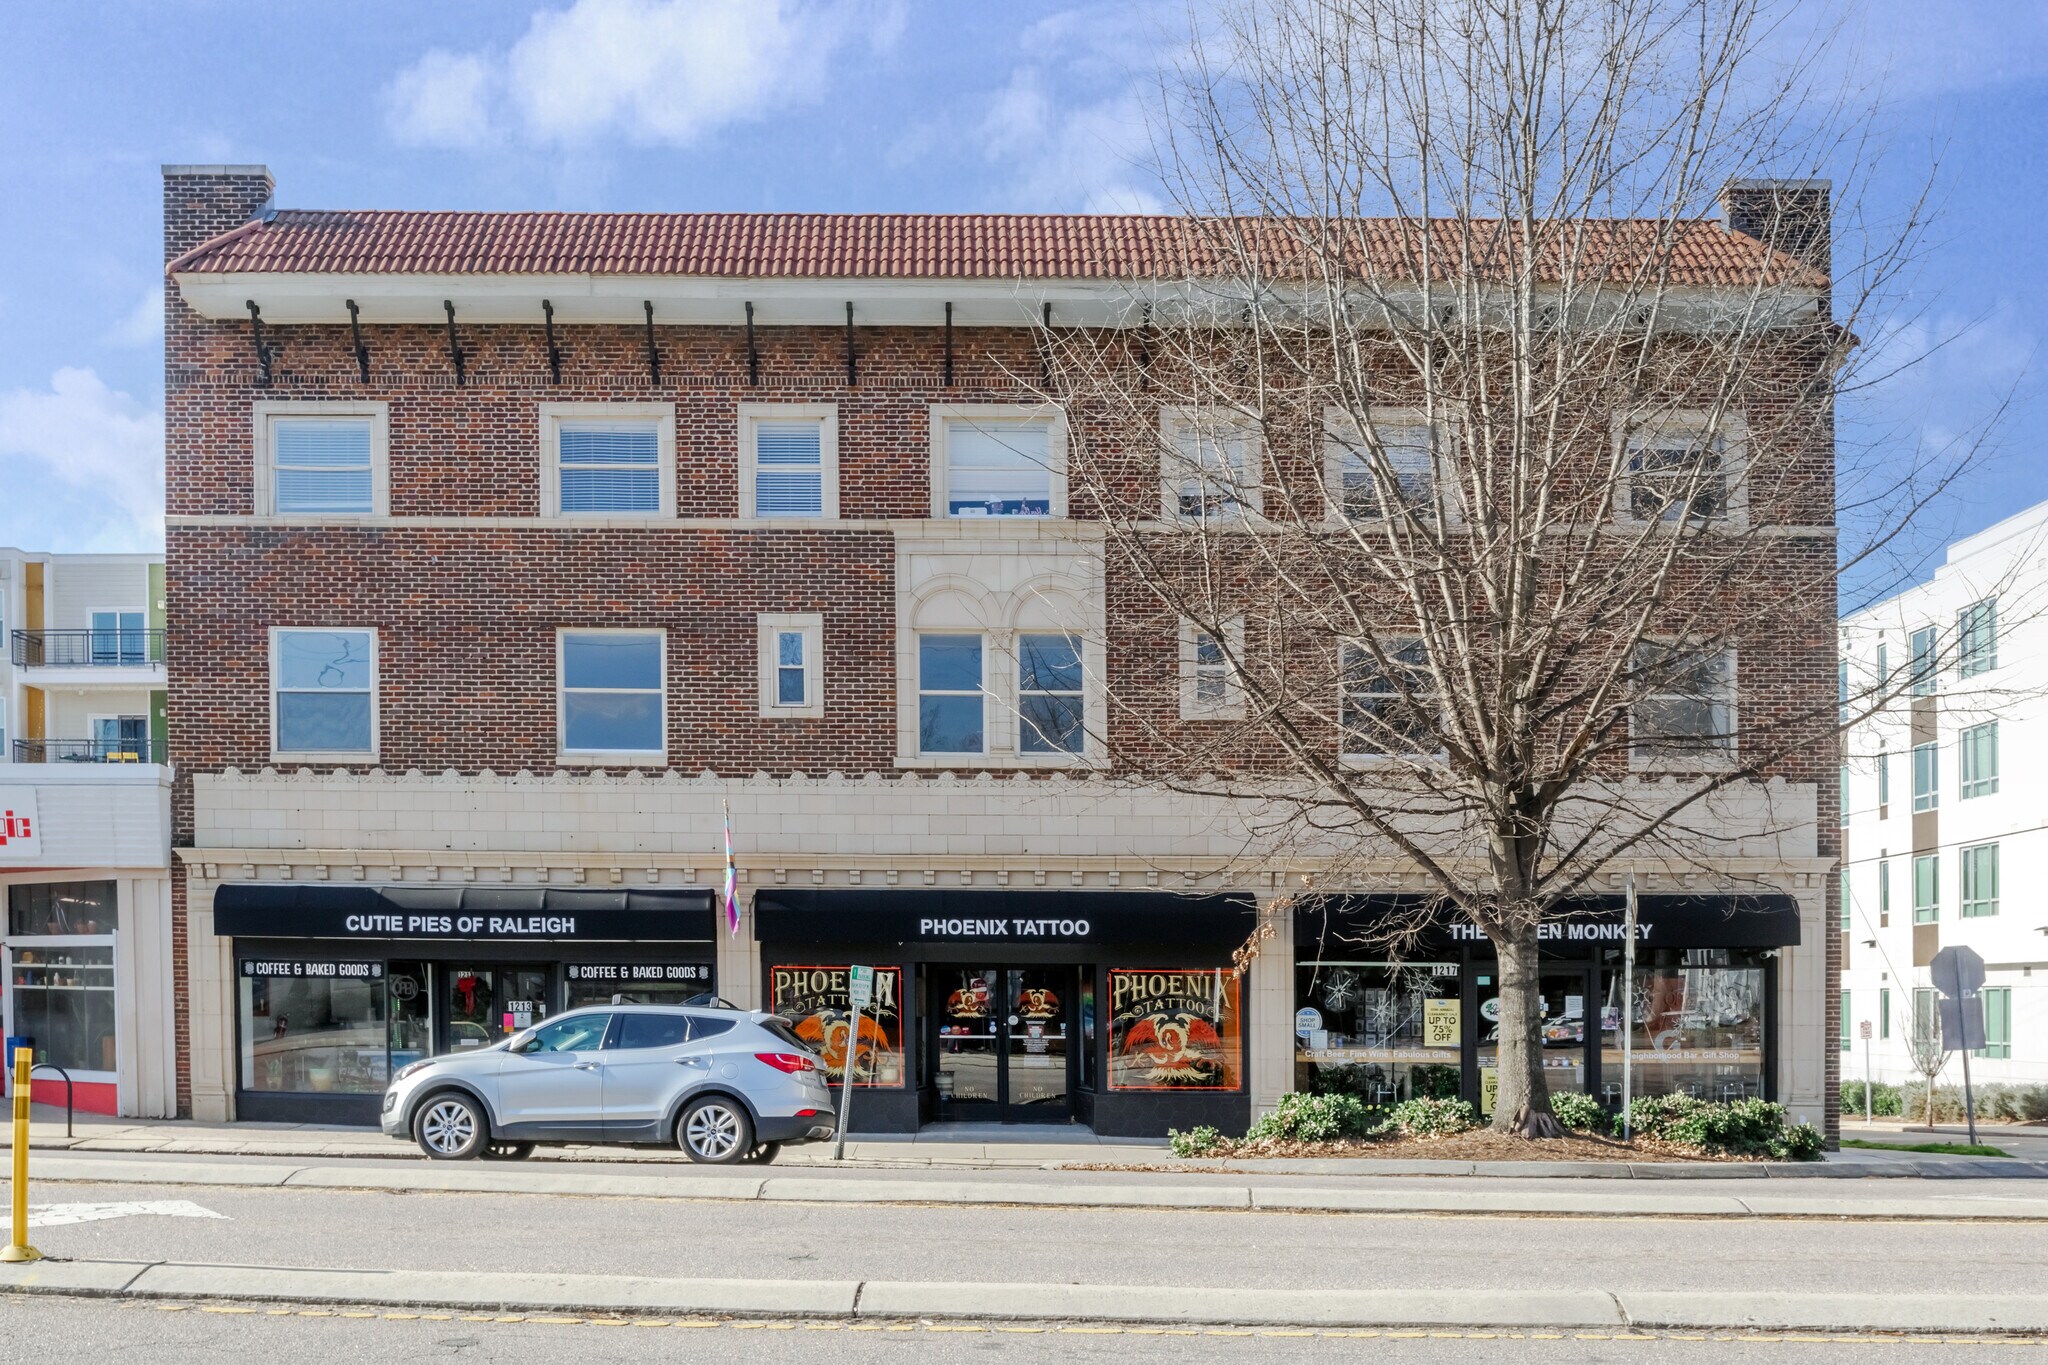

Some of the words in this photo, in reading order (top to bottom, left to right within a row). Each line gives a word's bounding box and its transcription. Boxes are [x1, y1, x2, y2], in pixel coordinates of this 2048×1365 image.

[346, 915, 404, 932] CUTIE
[408, 916, 452, 933] PIES
[457, 917, 484, 933] OF
[489, 917, 576, 934] RALEIGH
[920, 919, 1008, 936] PHOENIX
[1012, 919, 1090, 936] TATTOO
[256, 962, 291, 975] COFFEE
[294, 963, 302, 975] &
[305, 963, 336, 976] BAKED
[339, 964, 369, 976] GOODS
[581, 966, 617, 979] COFFEE
[620, 966, 629, 979] &
[632, 966, 663, 979] BAKED
[666, 966, 696, 979] GOODS
[1433, 965, 1457, 976] 1217
[395, 981, 418, 996] OPEN
[775, 971, 897, 1008] PHOEX
[1113, 974, 1233, 1011] PHOENIX
[509, 1002, 532, 1011] 1213
[805, 994, 862, 1009] TATT
[1143, 998, 1205, 1014] TATTOO
[1428, 1016, 1441, 1025] UP
[1443, 1016, 1456, 1025] TO
[1433, 1025, 1453, 1033] 75%
[1433, 1033, 1451, 1041] OFF
[1305, 1050, 1325, 1058] Craft
[1326, 1050, 1345, 1058] Beer
[1350, 1050, 1367, 1058] Fine
[1368, 1050, 1389, 1058] Wine
[1393, 1050, 1430, 1058] Fabulous
[1432, 1050, 1451, 1059] Gifts
[1629, 1050, 1681, 1061] eighborhood
[1683, 1051, 1698, 1059] Bar
[1702, 1050, 1717, 1059] Gift
[1718, 1051, 1740, 1060] Shop
